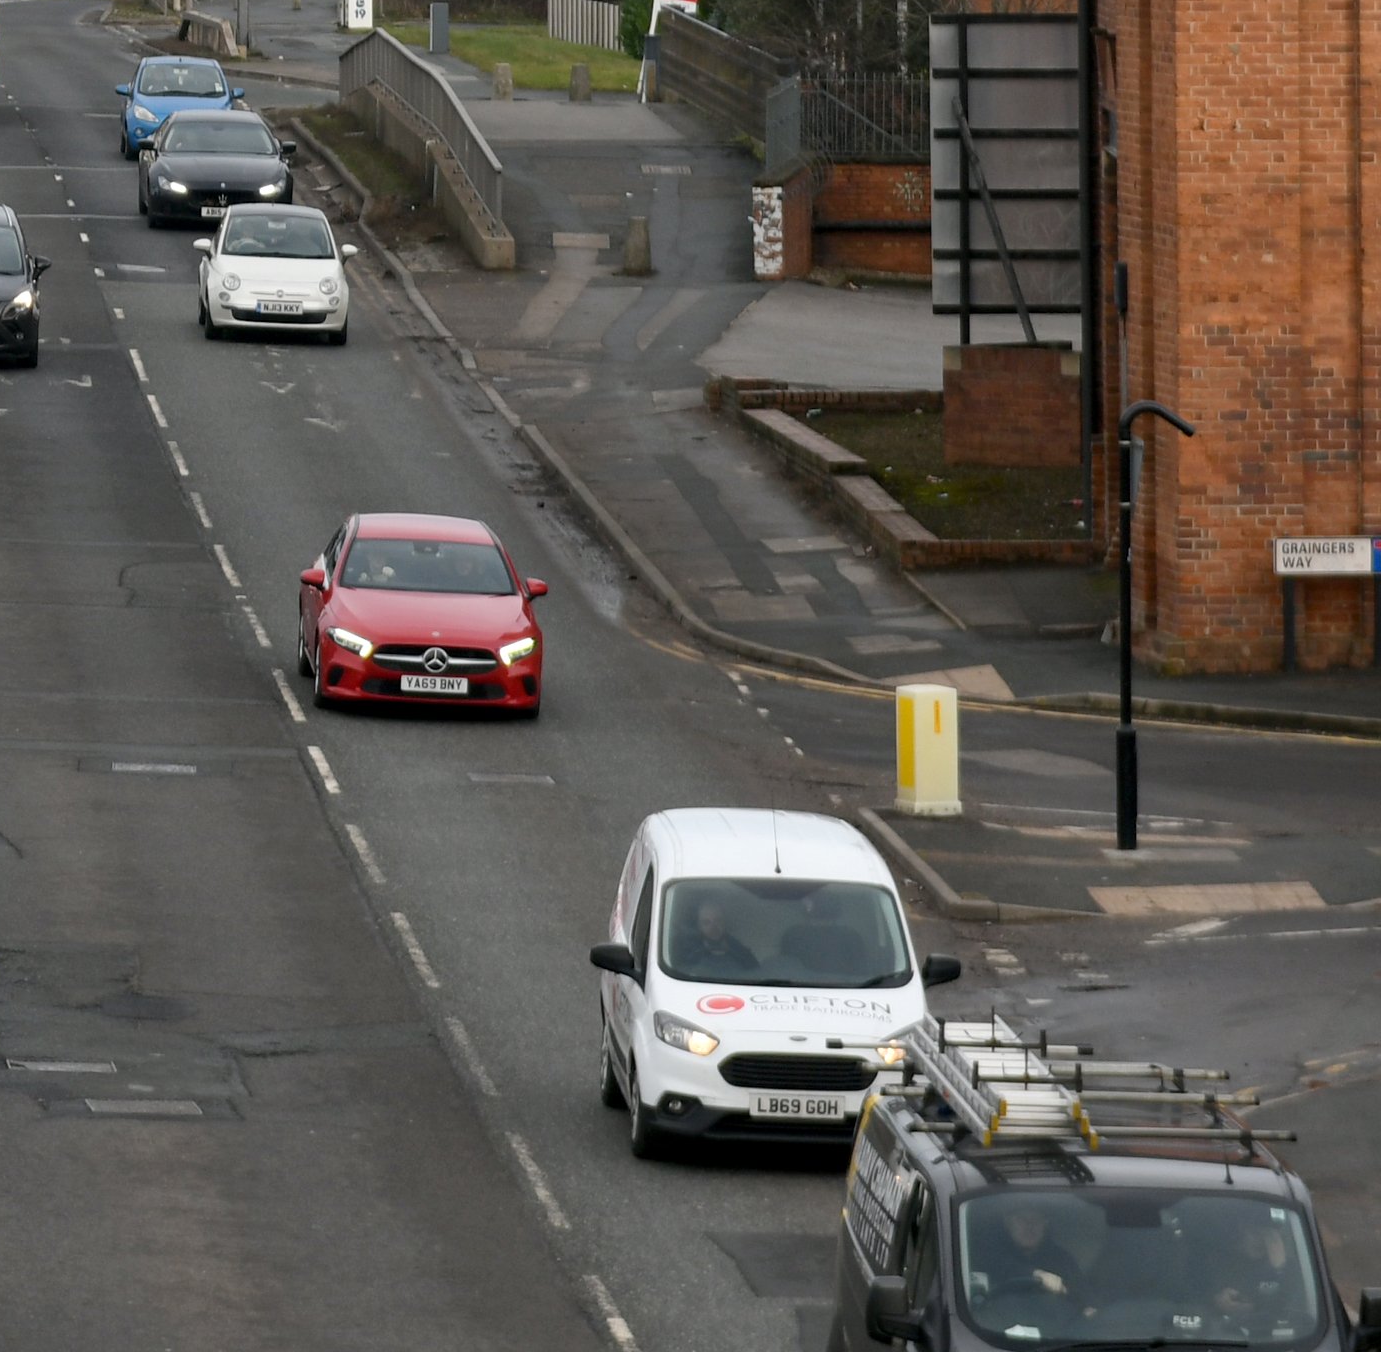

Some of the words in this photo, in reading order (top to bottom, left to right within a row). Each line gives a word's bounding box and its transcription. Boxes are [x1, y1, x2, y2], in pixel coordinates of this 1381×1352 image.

[355, 9, 366, 18] 19
[284, 304, 300, 312] KKY
[1281, 542, 1355, 554] GRAINGERS
[1282, 557, 1312, 568] WAY
[405, 677, 436, 689] YA69
[440, 678, 462, 690] BNY
[749, 994, 891, 1014] CLIFTON
[803, 1006, 892, 1023] BATHROOMS
[757, 1097, 800, 1113] LB69
[805, 1099, 837, 1115] GOH
